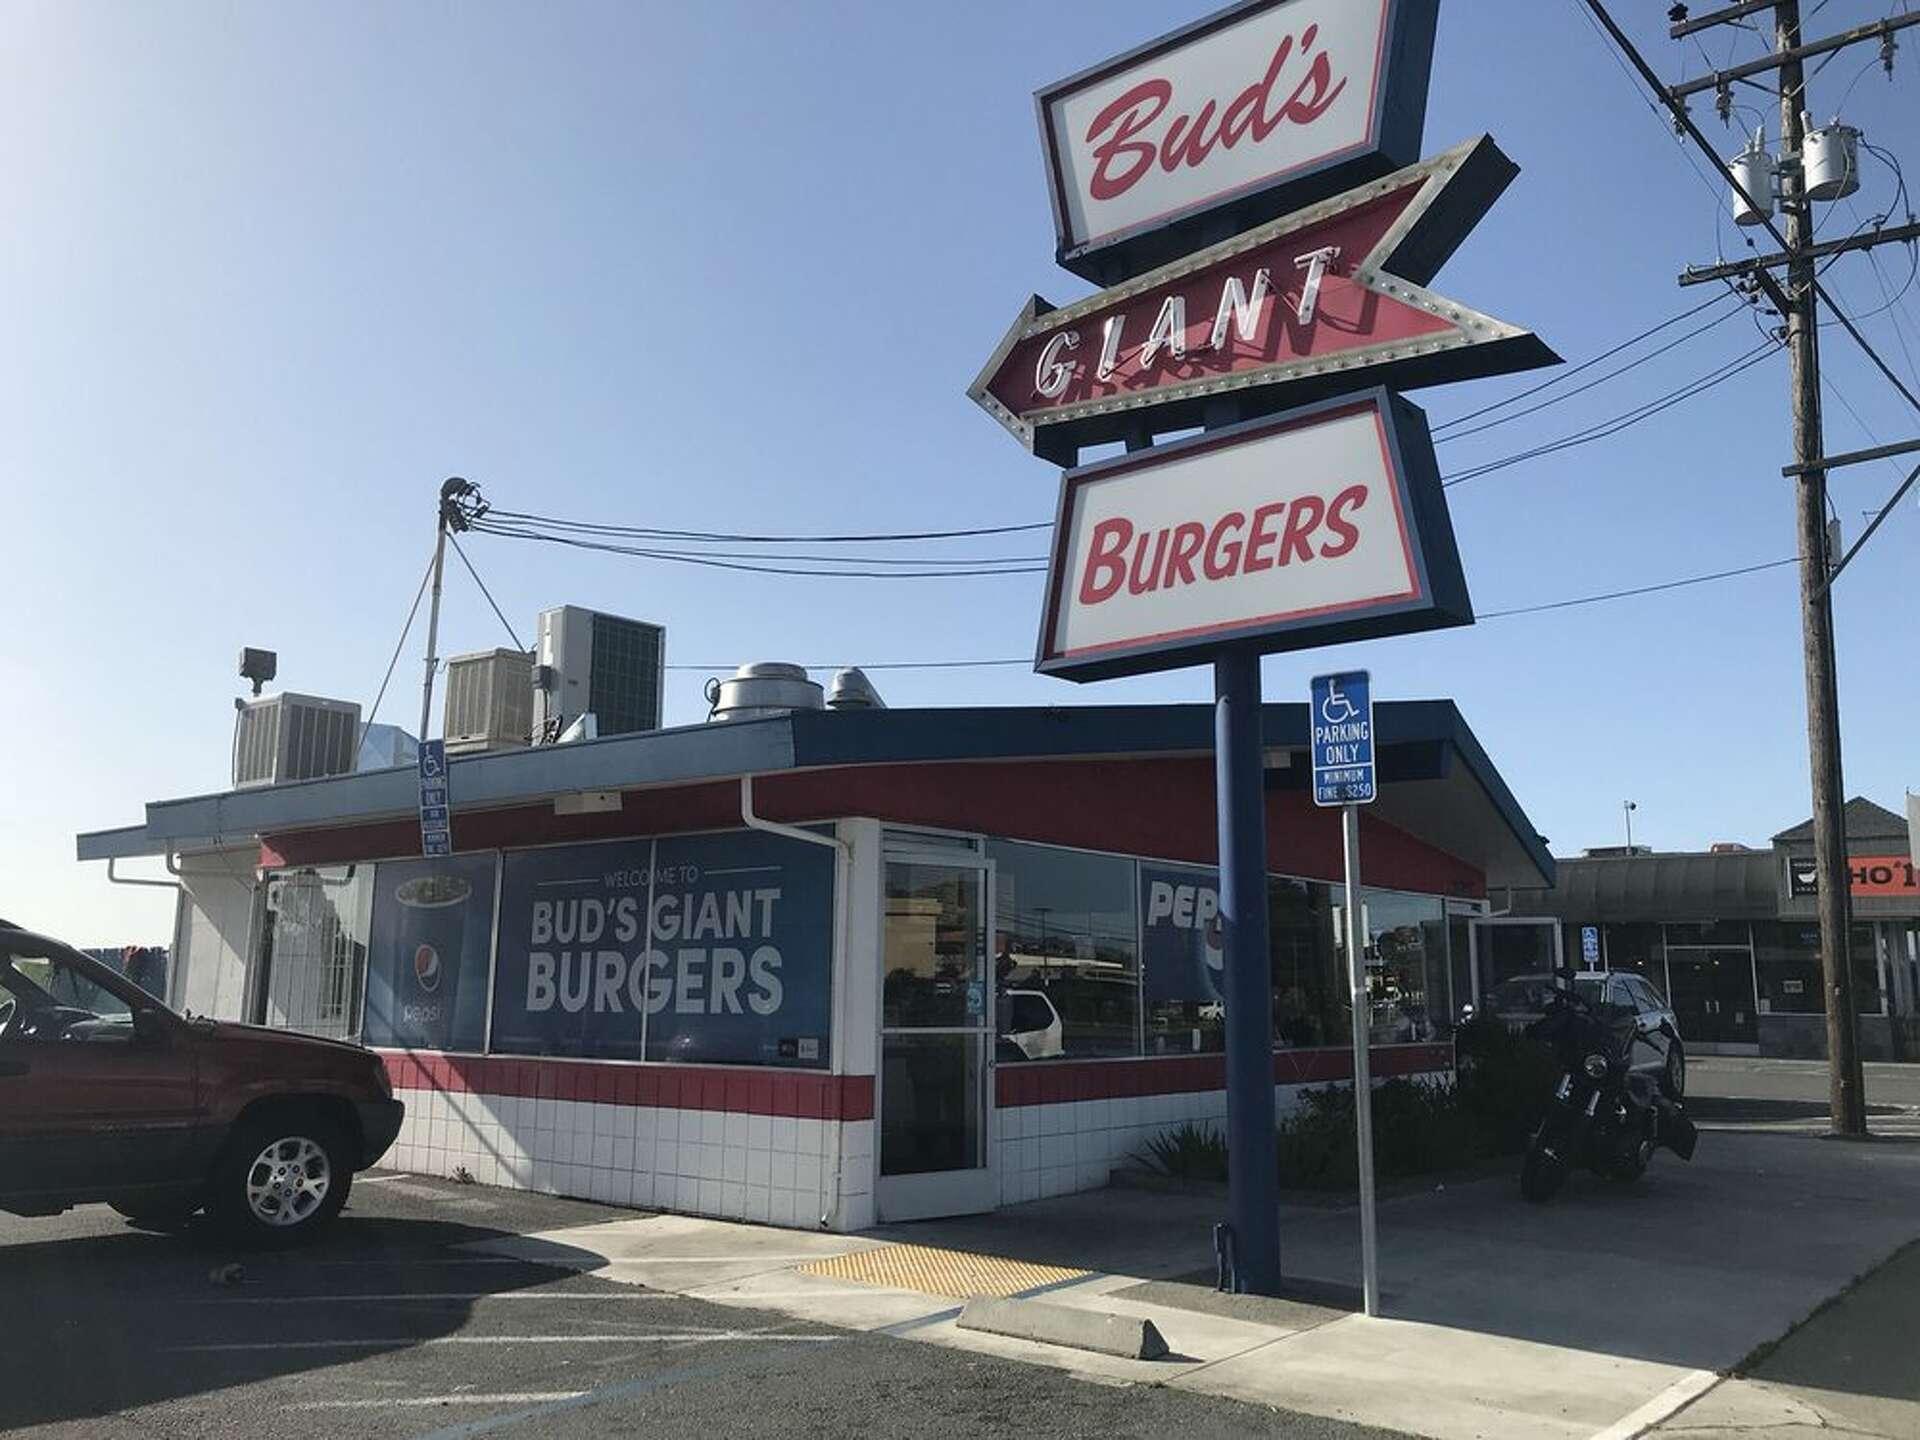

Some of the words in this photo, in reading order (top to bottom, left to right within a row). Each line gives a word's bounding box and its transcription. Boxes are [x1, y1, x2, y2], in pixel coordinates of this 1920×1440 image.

[1085, 23, 1347, 201] Bud's
[1036, 246, 1341, 398] GIANT
[1079, 484, 1368, 605] BURGERS
[1315, 721, 1369, 745] PARKING
[1326, 744, 1359, 764] ONLY
[1324, 769, 1364, 784] MINIMUM
[1346, 783, 1372, 798] $250
[679, 865, 699, 884] TO
[531, 896, 639, 944] BUD'S
[651, 888, 782, 942] GIANT
[1147, 880, 1222, 931] PEP
[525, 945, 784, 1015] BURGERS
